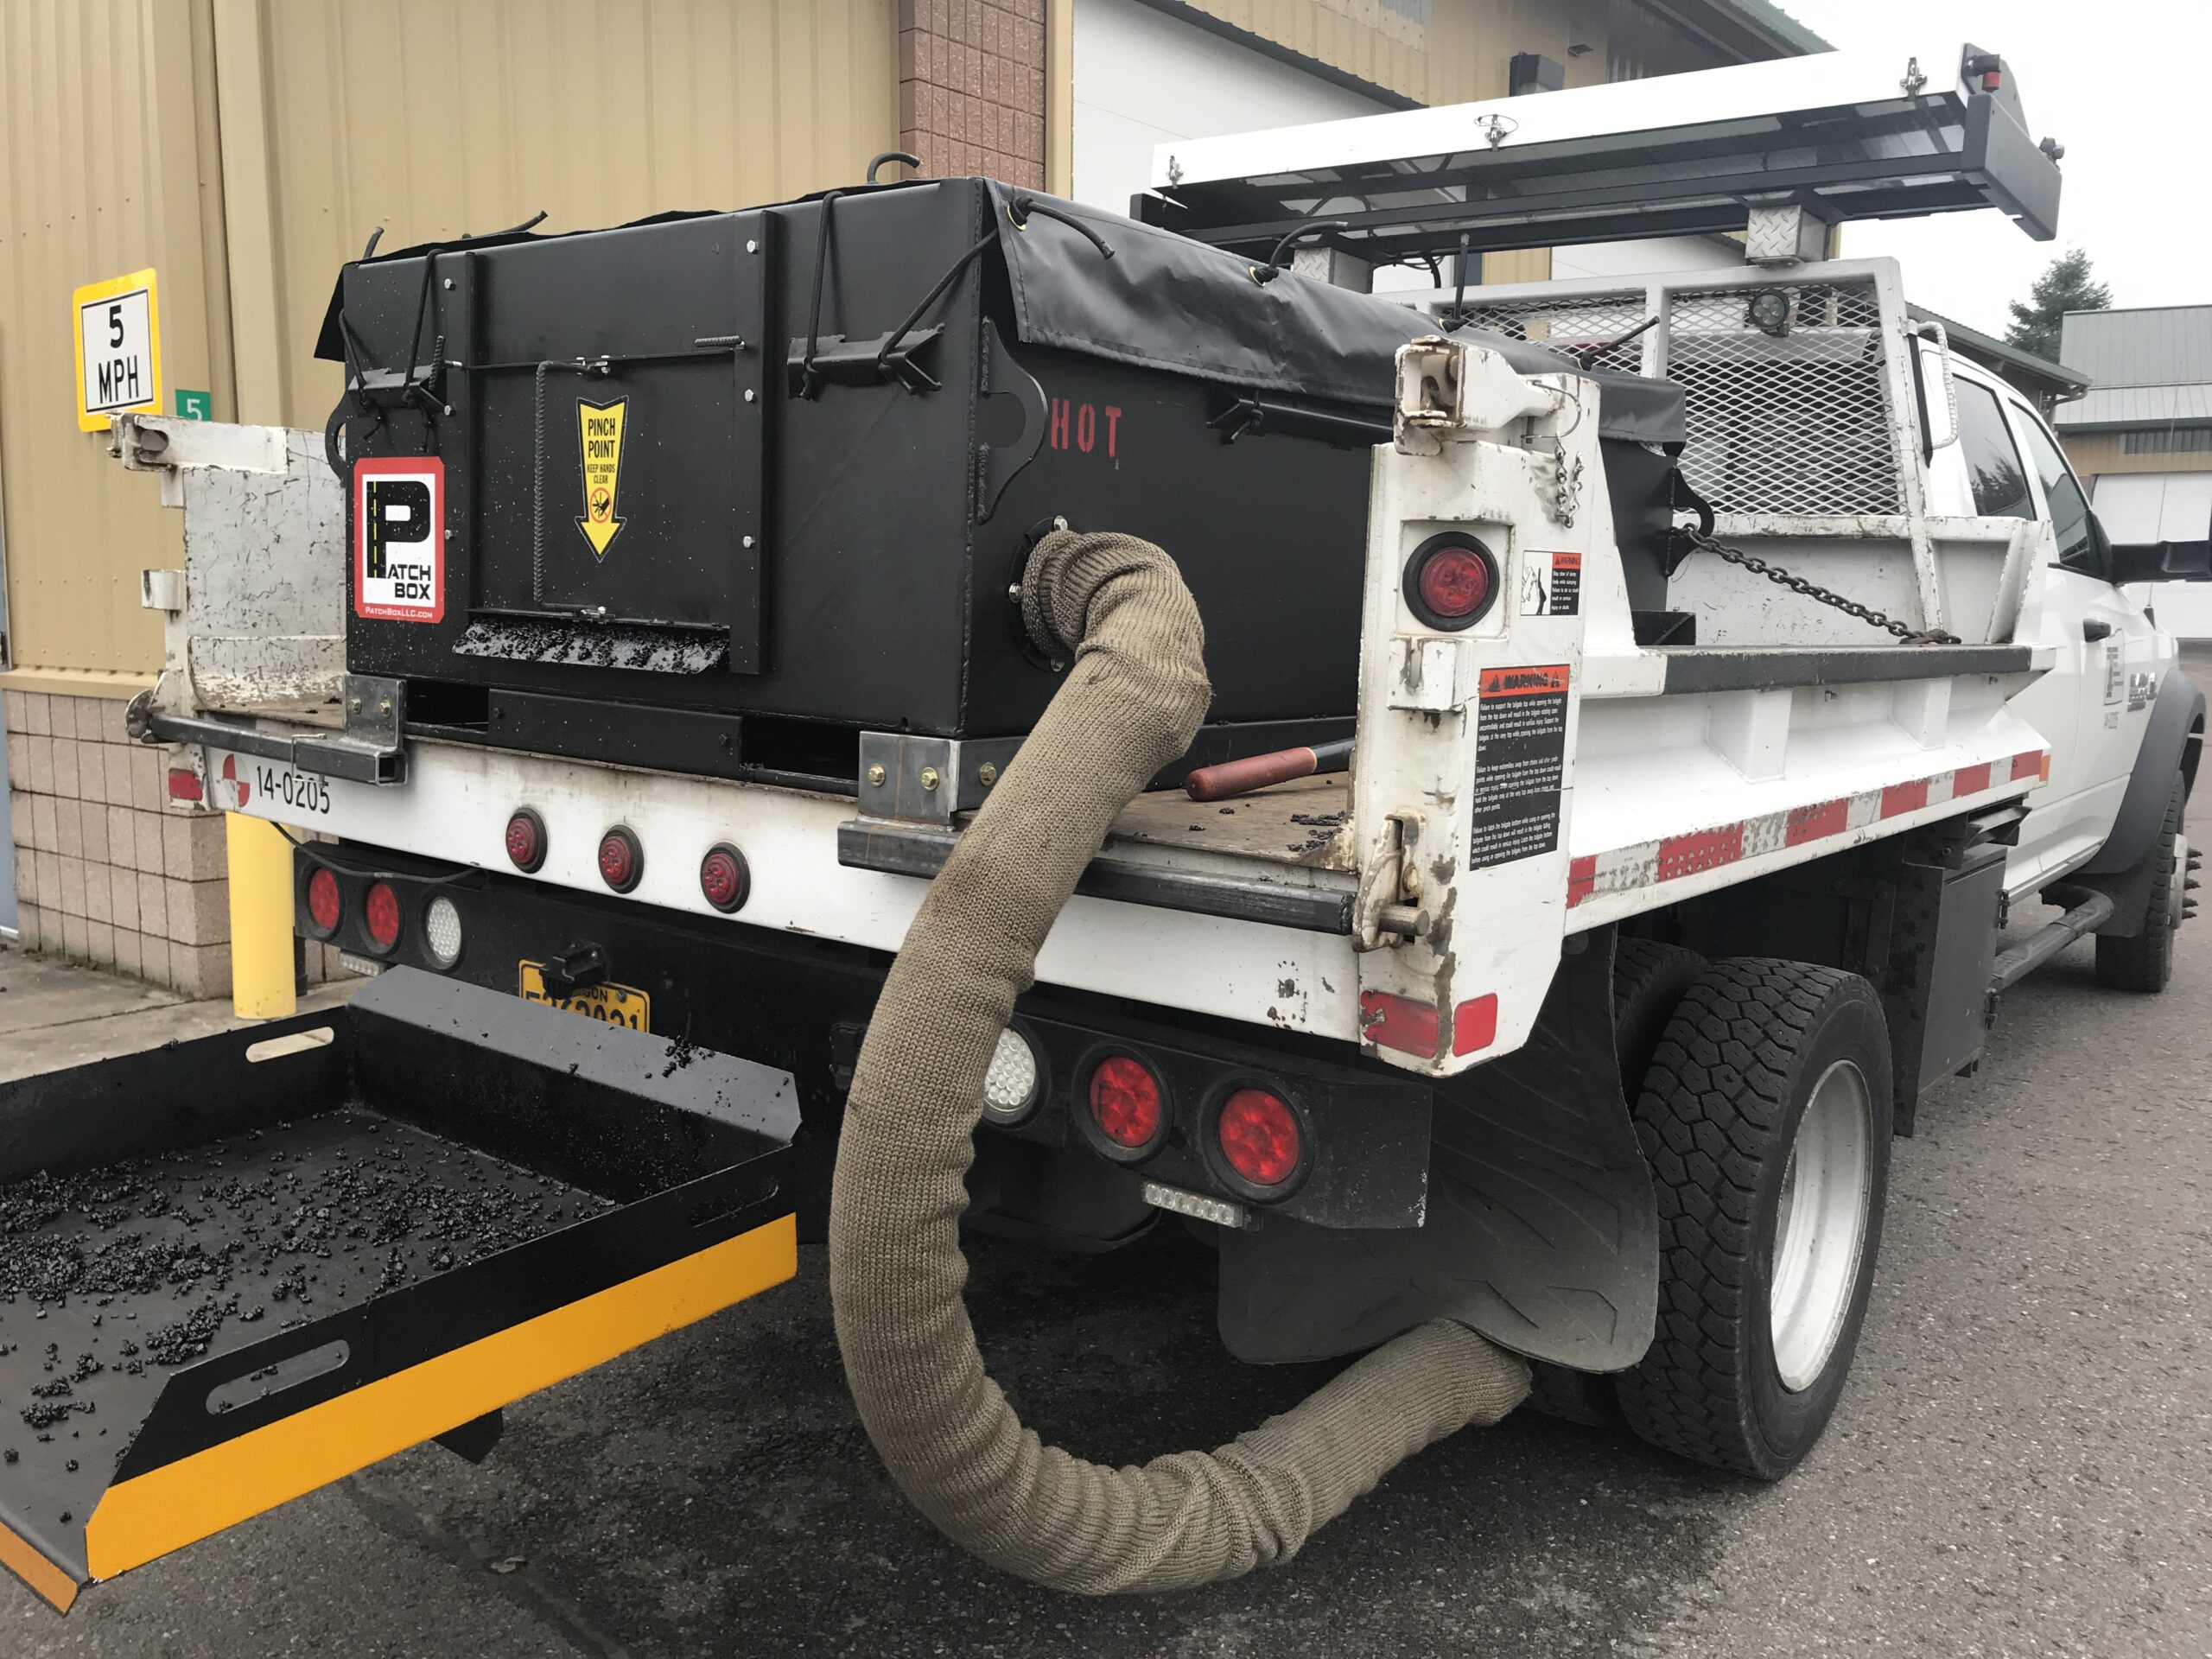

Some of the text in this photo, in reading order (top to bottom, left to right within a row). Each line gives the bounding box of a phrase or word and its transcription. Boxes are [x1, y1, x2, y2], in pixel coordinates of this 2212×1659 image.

[109, 304, 124, 348] 5
[99, 355, 139, 404] MPH
[588, 418, 616, 436] PINCH
[1051, 397, 1122, 458] HOT
[588, 440, 616, 459] POINT
[587, 464, 615, 474] KEEP HANDS
[594, 474, 608, 484] CLEAR
[395, 583, 431, 600] BOX
[257, 766, 330, 814] 14-0205
